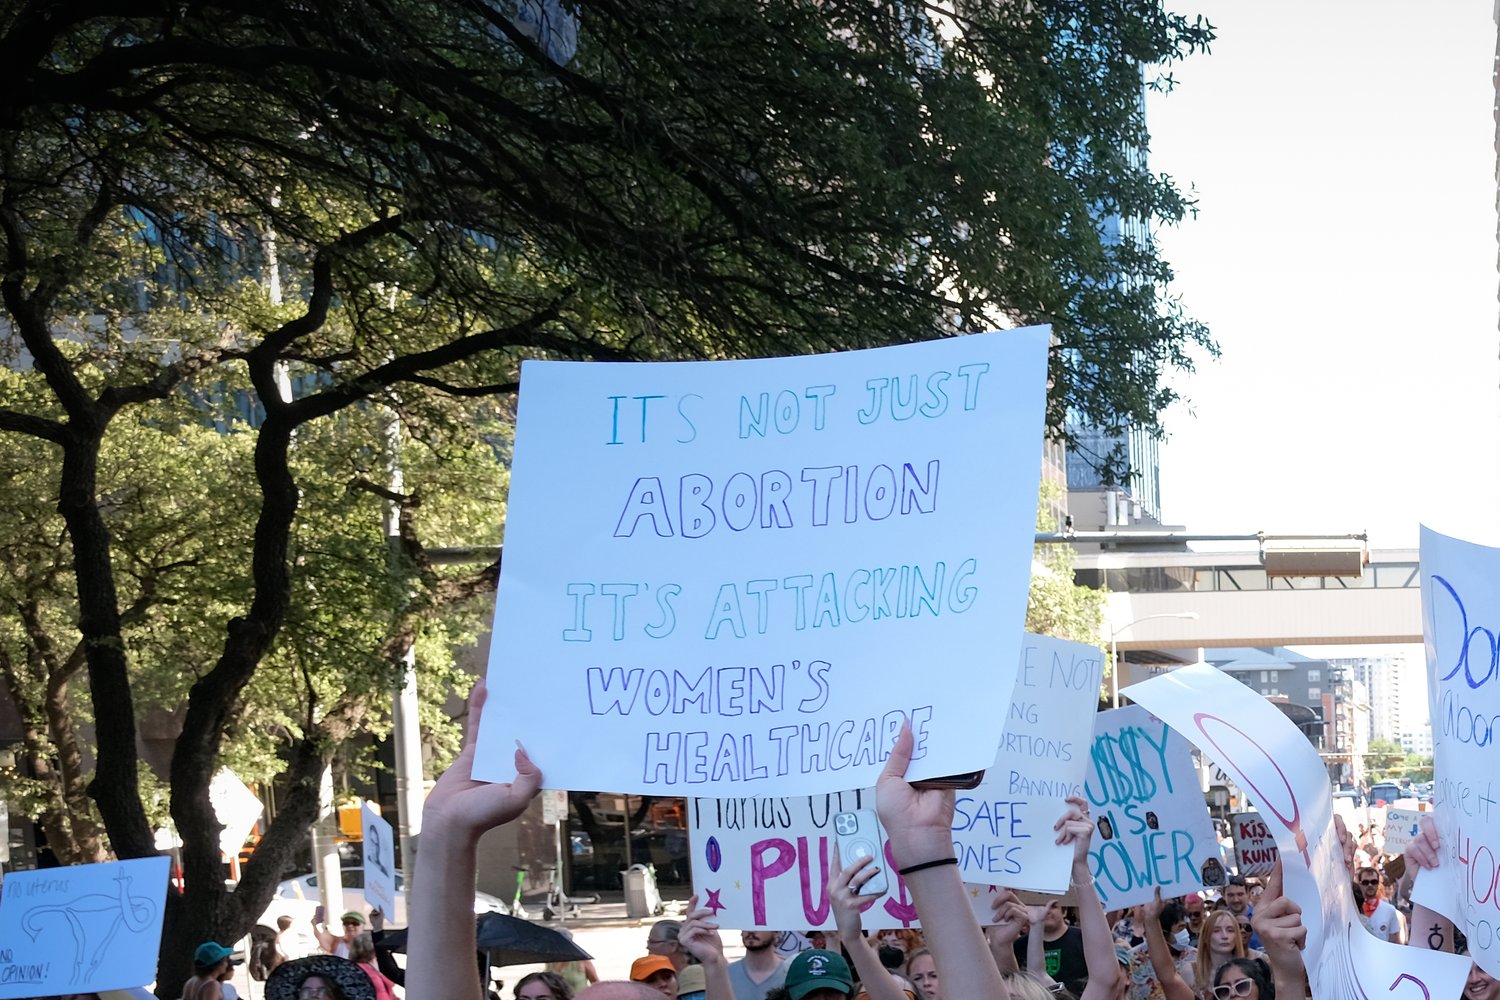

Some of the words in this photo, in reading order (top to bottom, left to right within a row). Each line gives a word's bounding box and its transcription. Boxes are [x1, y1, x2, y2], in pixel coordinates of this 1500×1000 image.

[738, 384, 837, 439] NOT
[857, 362, 990, 425] JUST
[612, 459, 941, 539] ABORTION
[562, 582, 683, 642] IT'S
[704, 557, 978, 640] ATTACKING
[586, 659, 832, 716] WOMEN'S
[1049, 651, 1100, 693] NOT
[642, 705, 933, 784] HEALTHCARE
[1008, 770, 1082, 799] BANNING
[950, 797, 1032, 839] SAFE
[1107, 804, 1148, 840] IS
[1240, 846, 1279, 865] KUNT
[1251, 838, 1264, 846] MY
